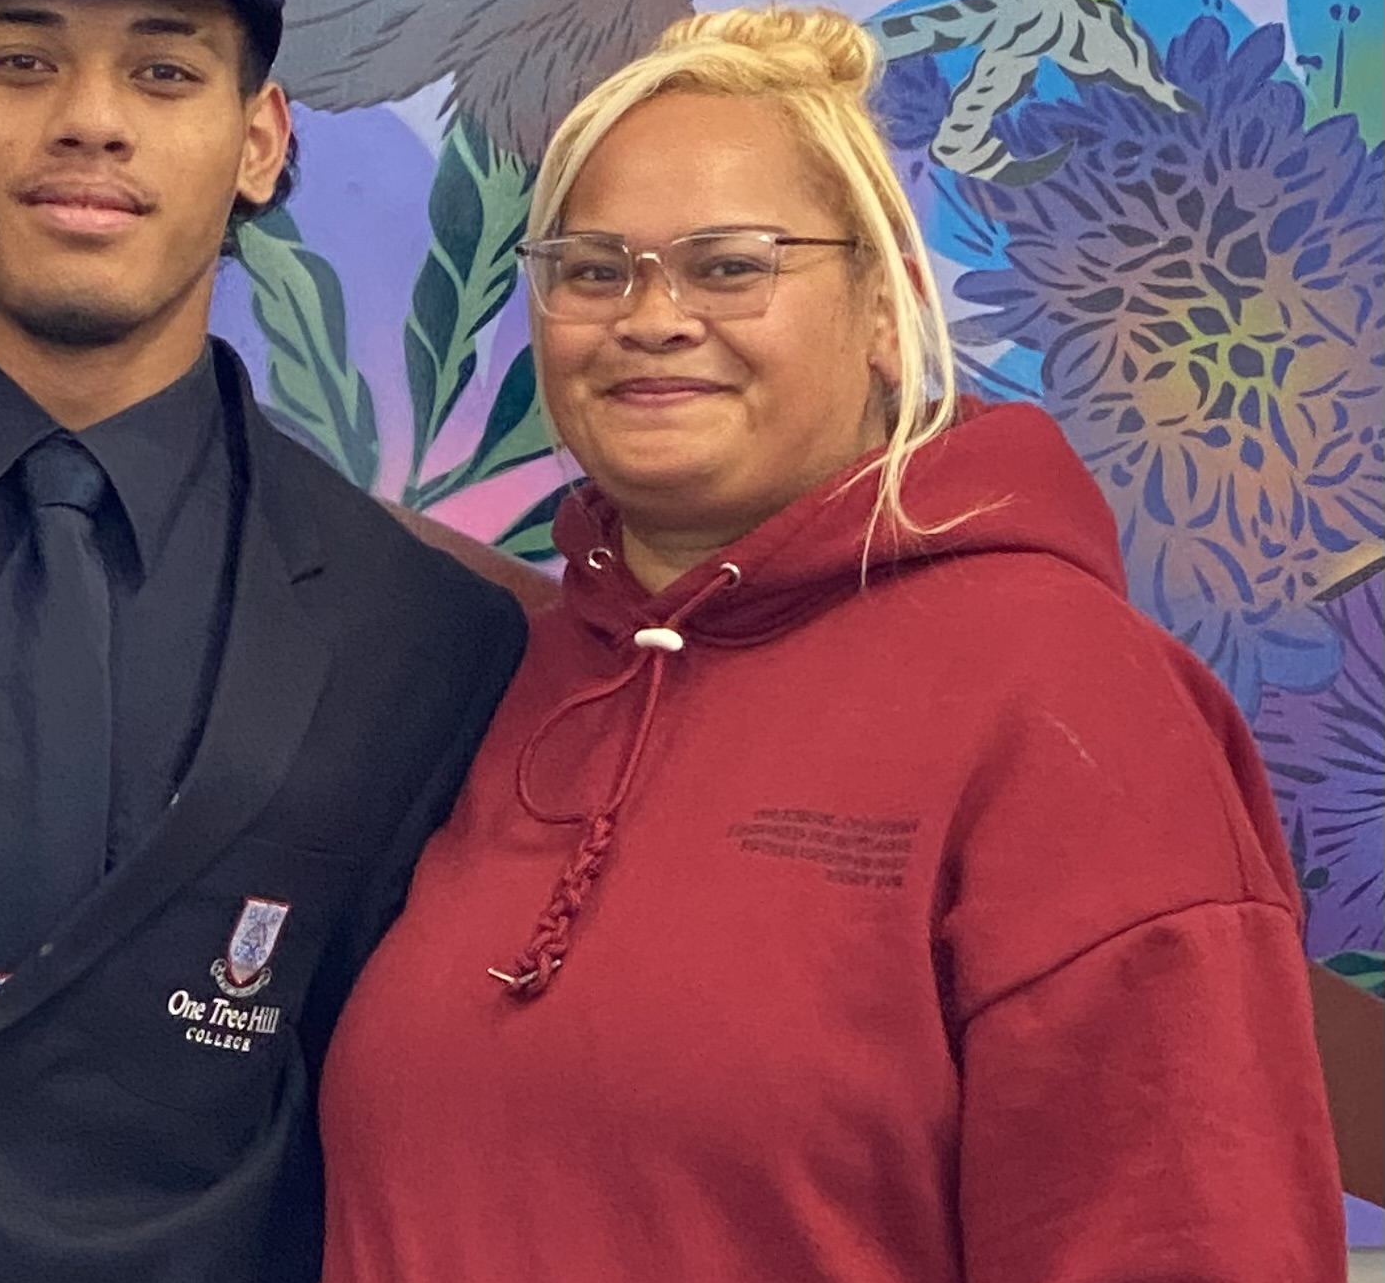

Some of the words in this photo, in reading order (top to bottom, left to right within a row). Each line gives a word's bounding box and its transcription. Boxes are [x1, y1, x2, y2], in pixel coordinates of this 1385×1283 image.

[168, 990, 206, 1021] One
[209, 998, 248, 1030] Tree
[247, 1005, 280, 1034] Hill
[185, 1027, 252, 1052] COLLEGE
